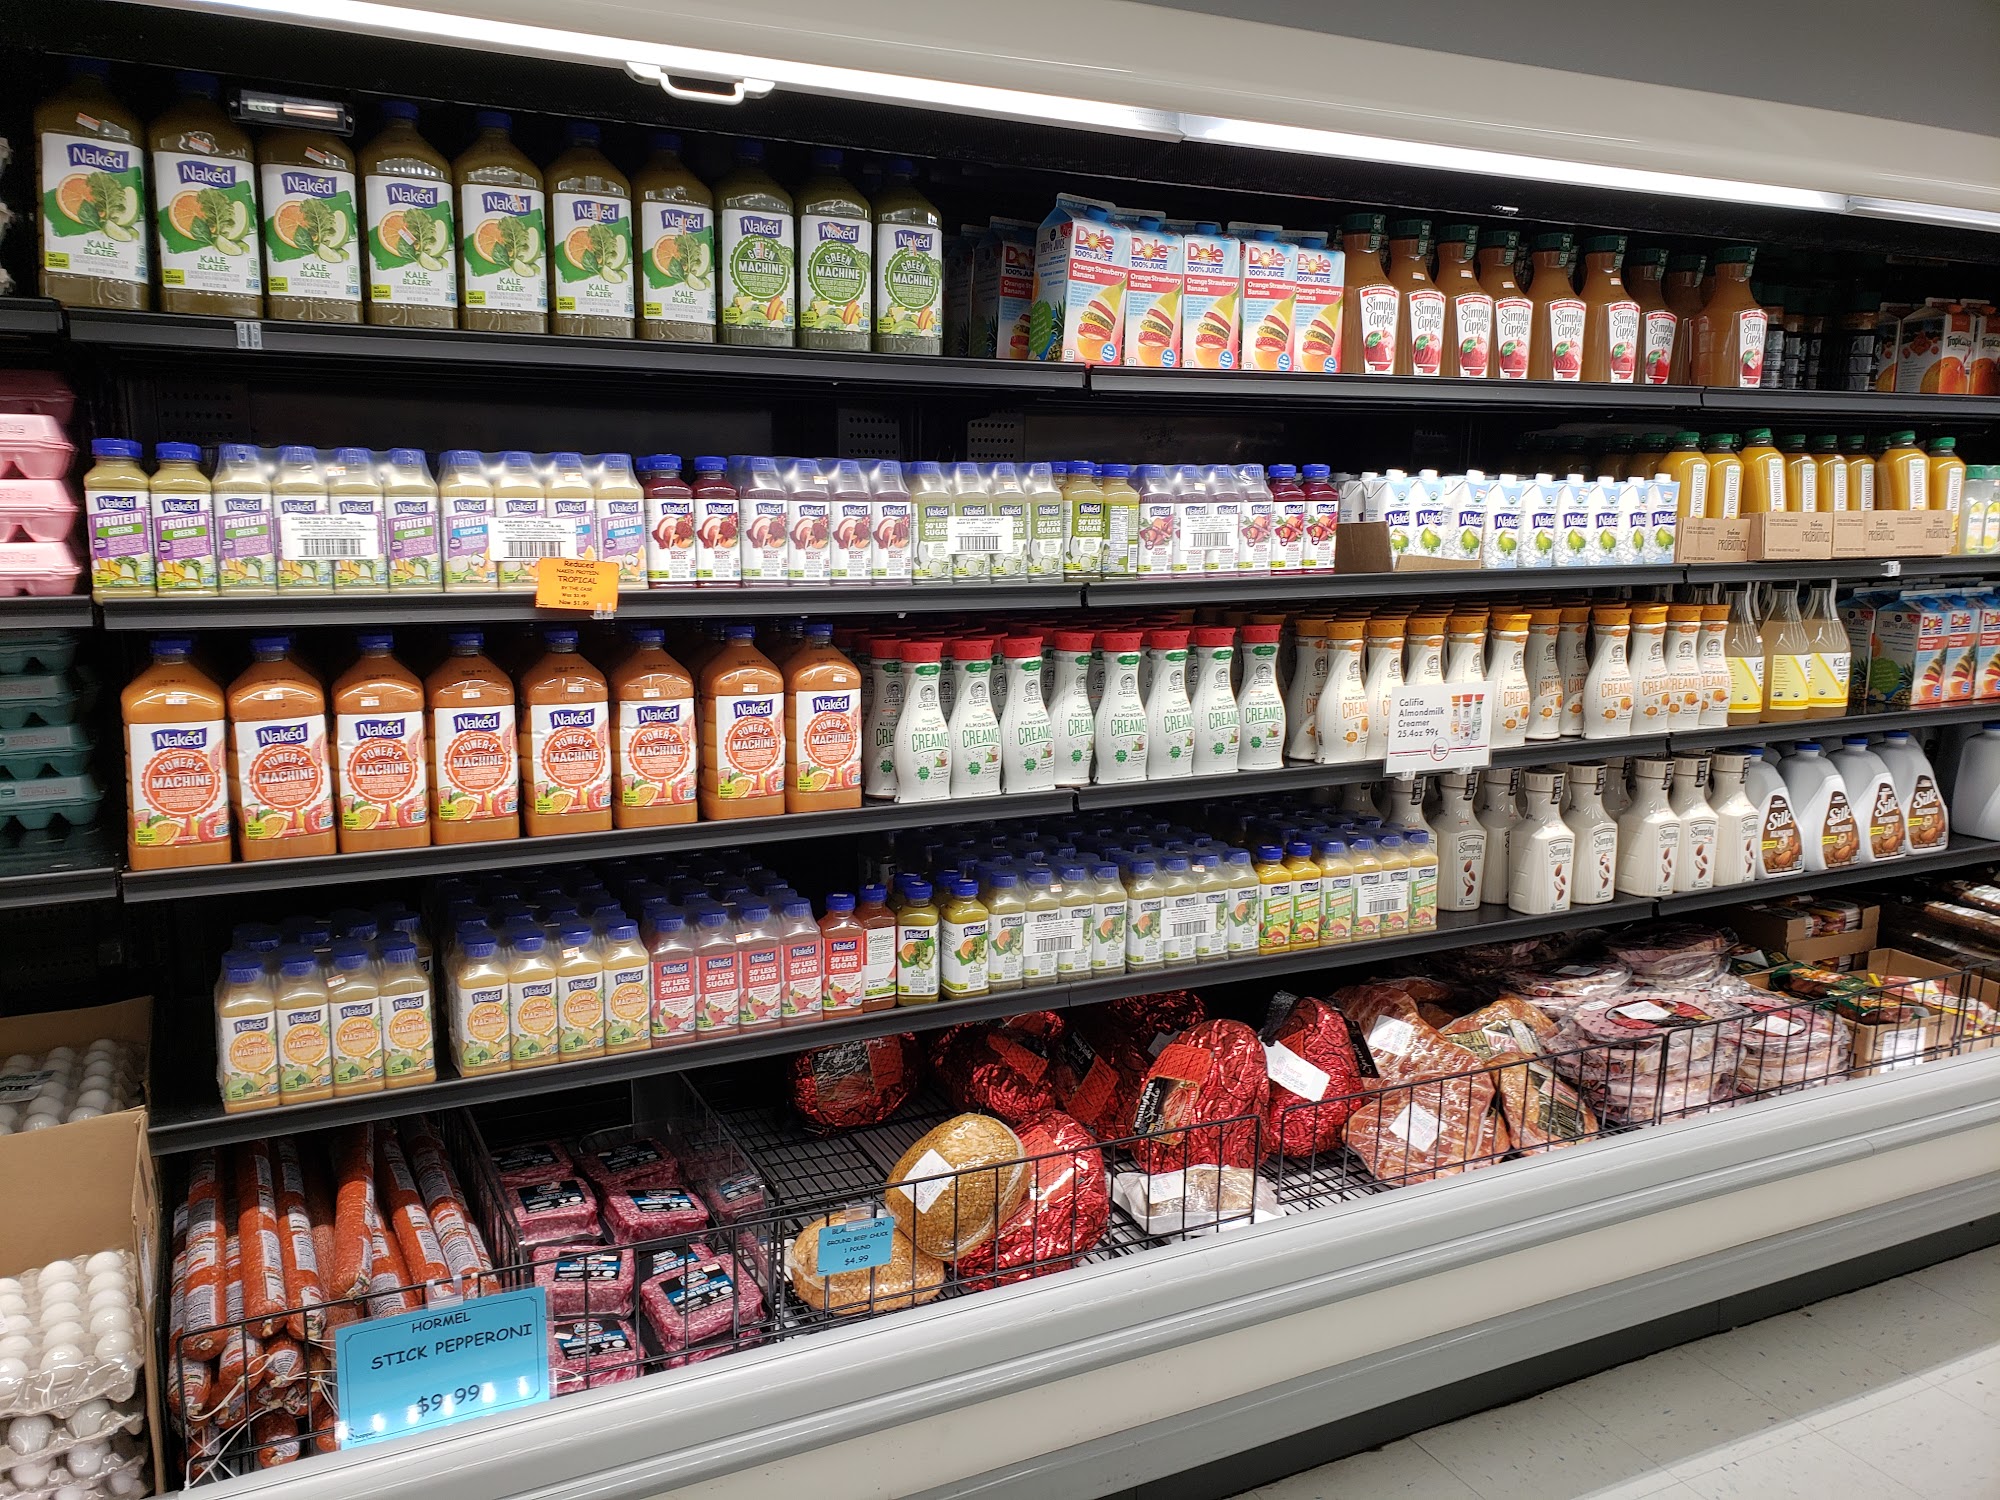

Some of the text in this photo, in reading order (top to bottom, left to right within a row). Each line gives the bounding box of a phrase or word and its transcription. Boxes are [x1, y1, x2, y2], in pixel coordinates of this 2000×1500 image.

[72, 150, 125, 170] Naked
[184, 166, 231, 184] Naked
[287, 177, 333, 195] Naked
[391, 187, 434, 205] Naked
[744, 220, 779, 236] Naked
[1076, 226, 1114, 250] Dole
[87, 239, 114, 250] KALE
[1131, 237, 1168, 258] Dole
[84, 246, 119, 259] BLAZER
[1075, 250, 1092, 258] 100%
[1188, 243, 1224, 262] Dole
[200, 255, 227, 265] KALE
[825, 254, 851, 265] GREEN
[1131, 261, 1167, 270] 100% JUICE
[197, 262, 230, 272] BLAZER
[303, 262, 327, 273] KALE
[739, 261, 784, 276] MACHINE
[902, 261, 926, 272] GREEN
[1073, 262, 1126, 278] Orange Strawberry
[300, 269, 330, 279] BLAZER
[405, 270, 428, 280] KALE
[816, 268, 861, 280] MACHINE
[1073, 271, 1095, 279] Banana
[1130, 273, 1181, 285] Orange Strawberry
[402, 277, 431, 287] BLAZER
[499, 277, 521, 286] KALE
[893, 275, 934, 286] MACHINE
[1187, 278, 1238, 288] Orange Strawberry
[497, 284, 524, 292] BLAZER
[1366, 297, 1396, 321] Simply
[1414, 301, 1443, 324] Simply
[1461, 307, 1490, 326] Simply
[1501, 309, 1529, 329] Simply
[100, 496, 134, 509] Naked
[165, 501, 198, 512] Naked
[457, 502, 484, 512] Naked
[611, 503, 637, 513] Naked
[663, 504, 689, 514] Naked
[758, 504, 783, 515] Naked
[1081, 504, 1101, 514] Naked
[1286, 505, 1304, 514] Naked
[96, 513, 142, 527] PROTEIN
[162, 518, 205, 530] PROTEIN
[608, 517, 644, 528] PROTEIN
[108, 526, 134, 535] GREENS
[173, 528, 197, 537] GREENS
[460, 527, 483, 536] TROPICAL
[614, 527, 636, 536] TROPICAL
[1868, 531, 1895, 541] PROBIOTICS
[1802, 531, 1830, 543] PROBIOTICS
[1718, 539, 1747, 551] PROBIOTICS
[558, 576, 597, 584] TROPICAL
[1922, 616, 1943, 628] Dole
[1399, 698, 1424, 707] Califia
[737, 702, 771, 716] Naked
[1399, 707, 1444, 717] Almondmilk
[459, 715, 498, 729] Naked
[553, 711, 593, 726] Naked
[261, 727, 304, 744] Naked
[738, 725, 771, 737] POWER-C
[1398, 730, 1423, 738] 25.4oz
[156, 732, 203, 747] Naked
[459, 739, 498, 752] POWER-C
[555, 735, 593, 748] POWER-C
[733, 738, 776, 750] MACHINE
[264, 752, 307, 769] POWER-C
[453, 755, 504, 767] MACHINE
[550, 750, 599, 763] MACHINE
[158, 756, 202, 772] POWER-C
[259, 768, 316, 783] MACHINE
[152, 775, 212, 789] MACHINE
[1914, 791, 1938, 808] Silk
[1768, 812, 1792, 830] Silk
[1828, 806, 1851, 826] Silk
[906, 930, 928, 939] Naked
[833, 941, 856, 951] Naked
[664, 964, 687, 974] Naked
[830, 962, 858, 970] SUGAR
[617, 973, 641, 983] Naked
[673, 978, 690, 986] LESS
[660, 985, 690, 994] SUGAR
[396, 999, 422, 1009] Naked
[615, 997, 646, 1006] MACHINE
[290, 1012, 319, 1024] Naked
[394, 1022, 429, 1034] MACHINE
[287, 1038, 324, 1050] MACHINE
[827, 1238, 851, 1246] GROUND
[870, 1231, 888, 1239] CHUCK
[845, 1255, 869, 1266] $4.99
[412, 1312, 471, 1333] HORMEL
[371, 1323, 533, 1370] STICK PEPPERONI
